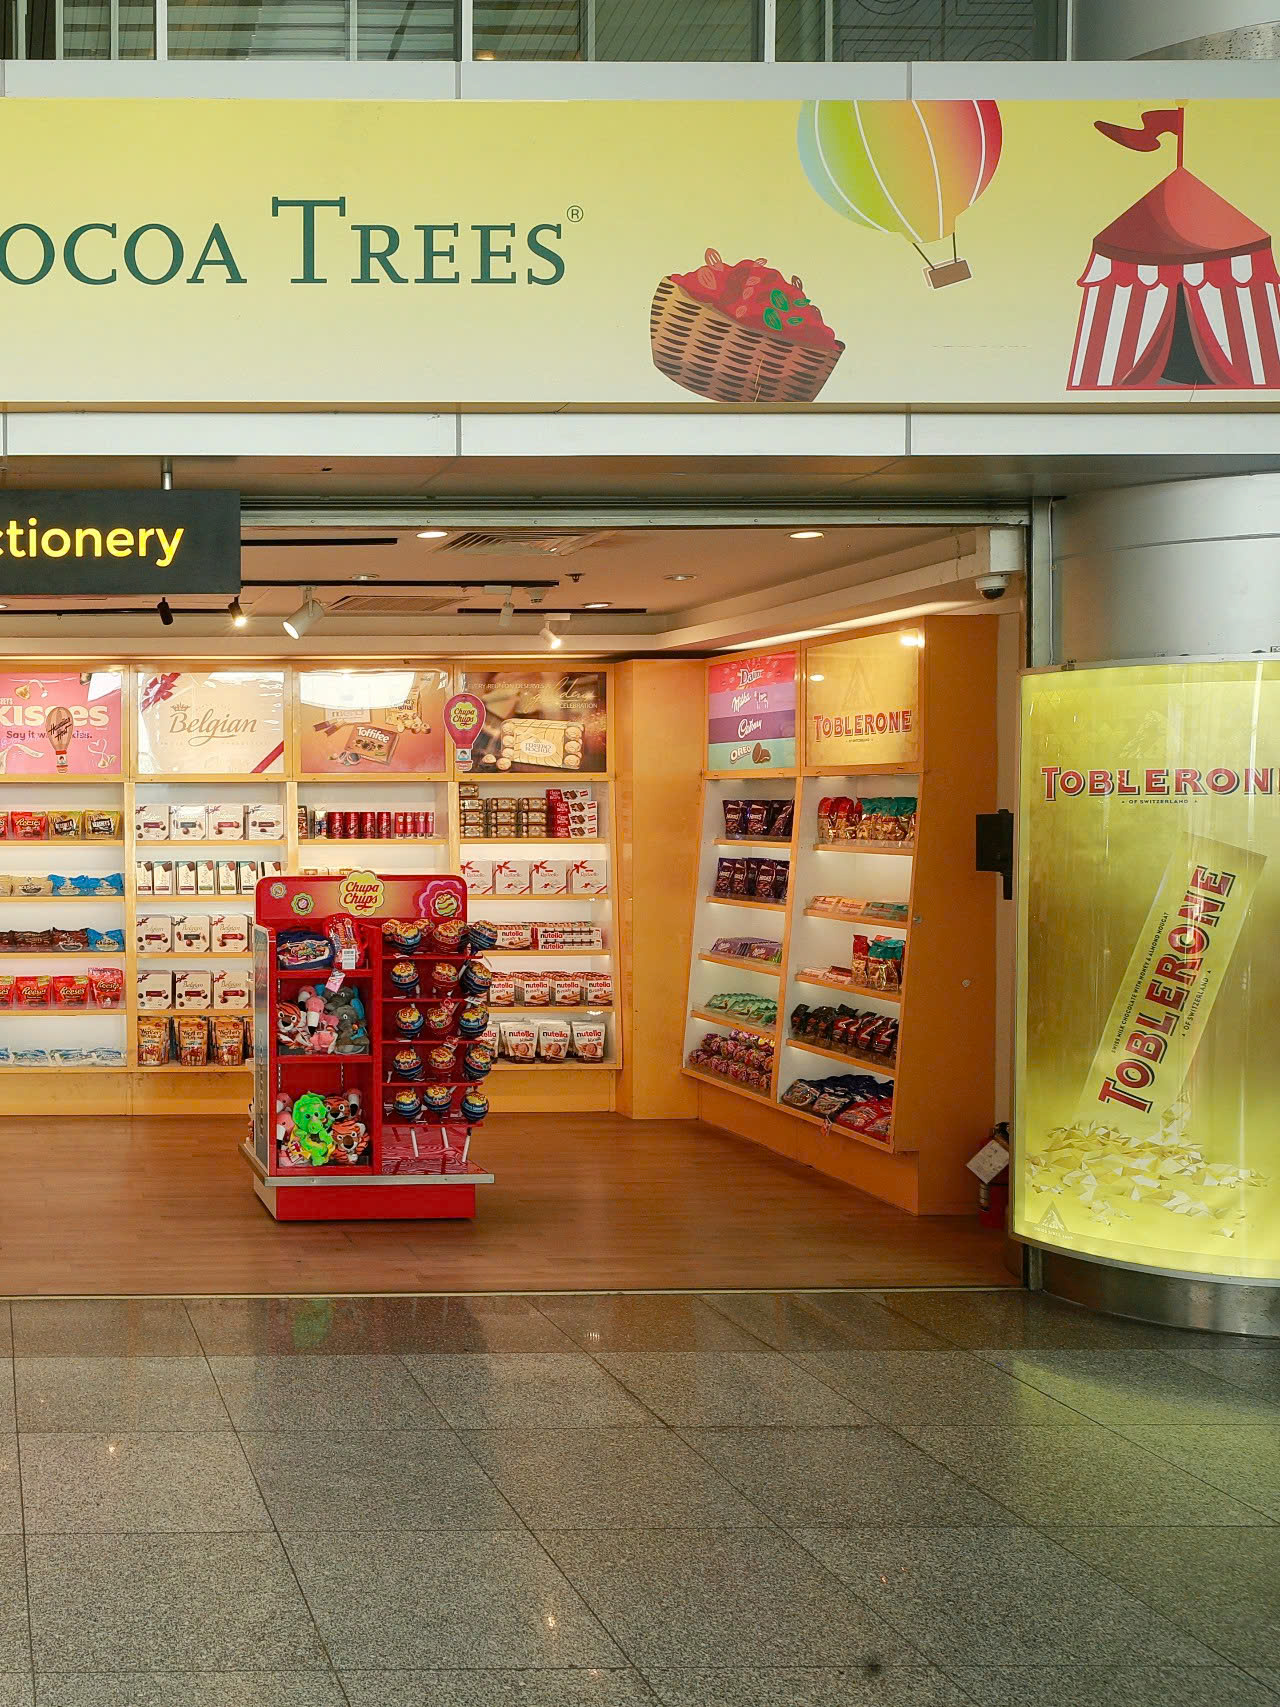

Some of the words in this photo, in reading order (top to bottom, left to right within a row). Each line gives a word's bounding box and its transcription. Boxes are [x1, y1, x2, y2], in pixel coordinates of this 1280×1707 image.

[271, 195, 566, 287] TREES
[452, 714, 474, 727] Chups
[453, 707, 476, 718] Chupa
[169, 708, 257, 747] Belgian
[356, 725, 390, 743] Toffifee
[812, 709, 912, 743] TOBLERONE
[6, 730, 26, 742] Say
[28, 730, 35, 739] it
[729, 745, 751, 764] OREO
[1041, 766, 1280, 802] TOBLERON
[345, 882, 380, 895] Chupa
[344, 892, 379, 910] Chups
[1122, 993, 1137, 1025] CHOCOLATE
[1134, 980, 1143, 994] WITH
[1139, 961, 1150, 981] HONEY
[1148, 934, 1160, 958] ALMOND
[1097, 865, 1237, 1114] TOBLERONE
[1187, 977, 1209, 1021] SWITZERLAND
[508, 1030, 534, 1038] nutella
[542, 1030, 568, 1038] nutella
